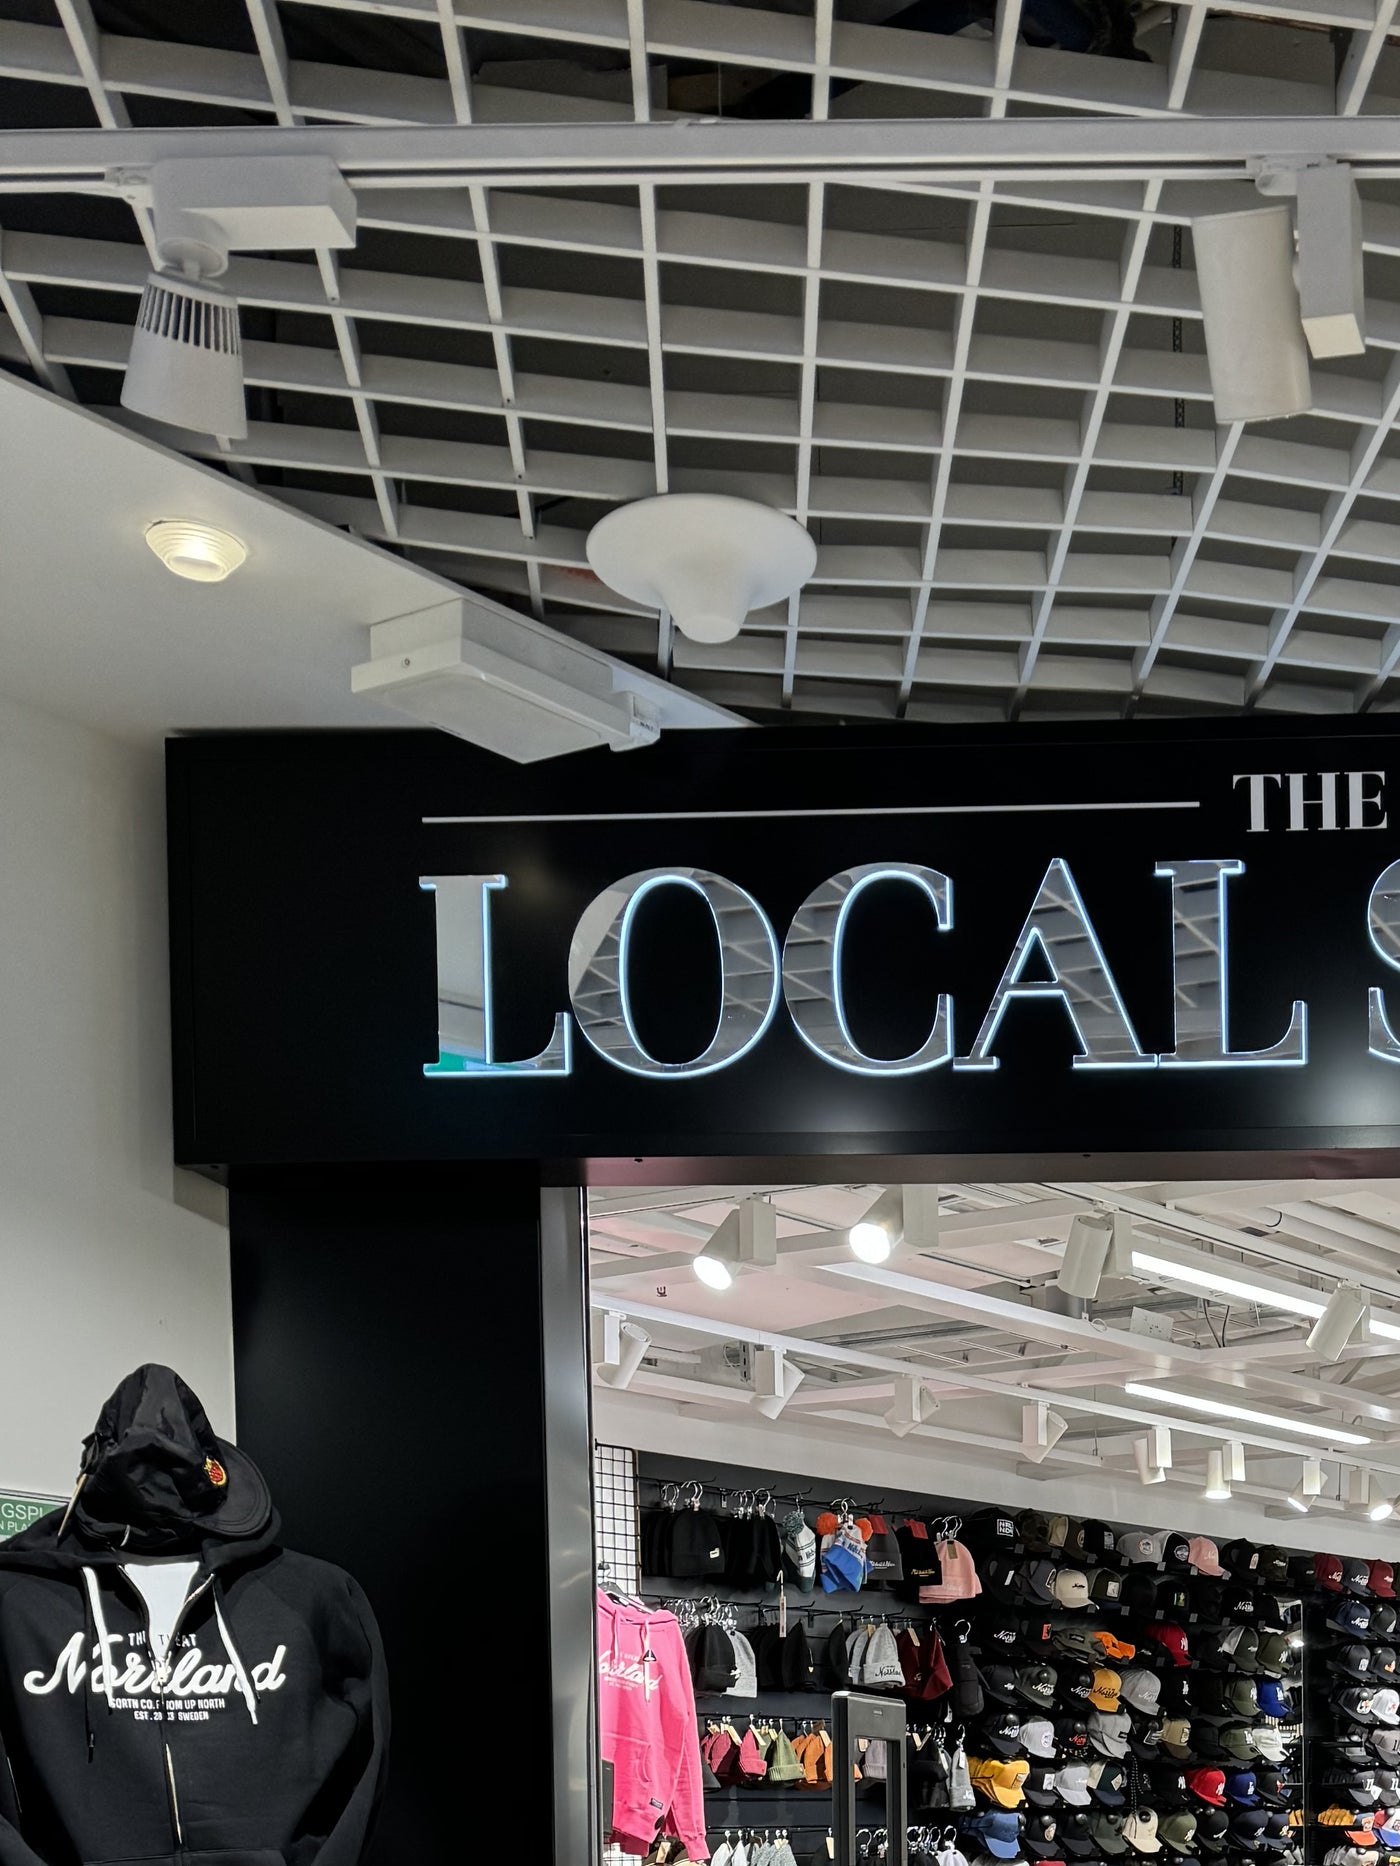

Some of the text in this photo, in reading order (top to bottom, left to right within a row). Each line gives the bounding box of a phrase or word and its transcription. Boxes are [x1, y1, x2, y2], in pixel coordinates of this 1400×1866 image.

[1233, 771, 1388, 833] THE
[419, 858, 1307, 1077] LOCAL
[178, 1711, 209, 1720] SWEDEN
